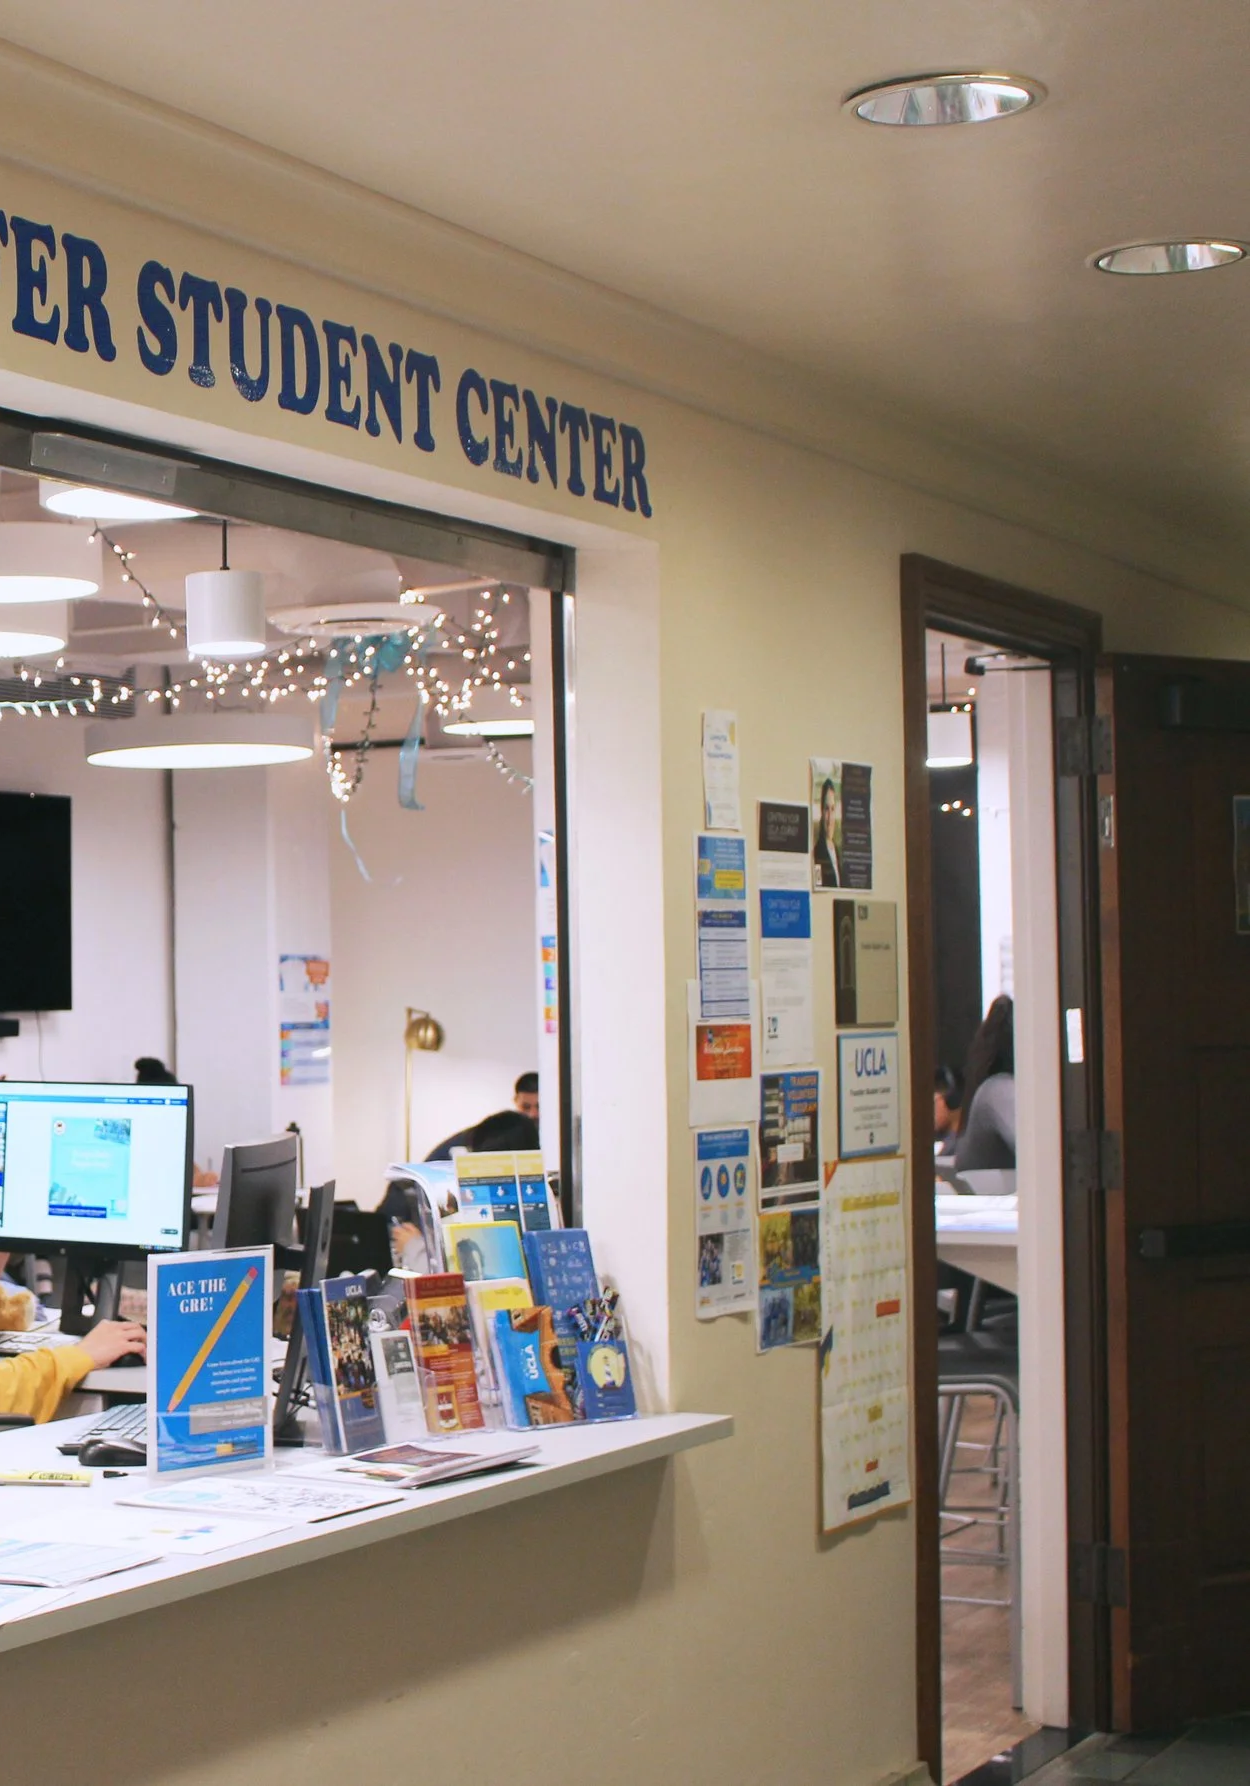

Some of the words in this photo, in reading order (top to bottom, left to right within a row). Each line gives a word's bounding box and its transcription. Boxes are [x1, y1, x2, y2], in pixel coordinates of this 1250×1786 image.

[137, 260, 441, 454] STUDENT
[456, 368, 652, 519] CENTER
[855, 1047, 887, 1077] UCLA
[168, 1280, 195, 1297] ACE
[198, 1277, 227, 1294] THE
[345, 1284, 363, 1298] UCLA
[179, 1296, 214, 1314] GRE!
[524, 1344, 540, 1381] UCLA
